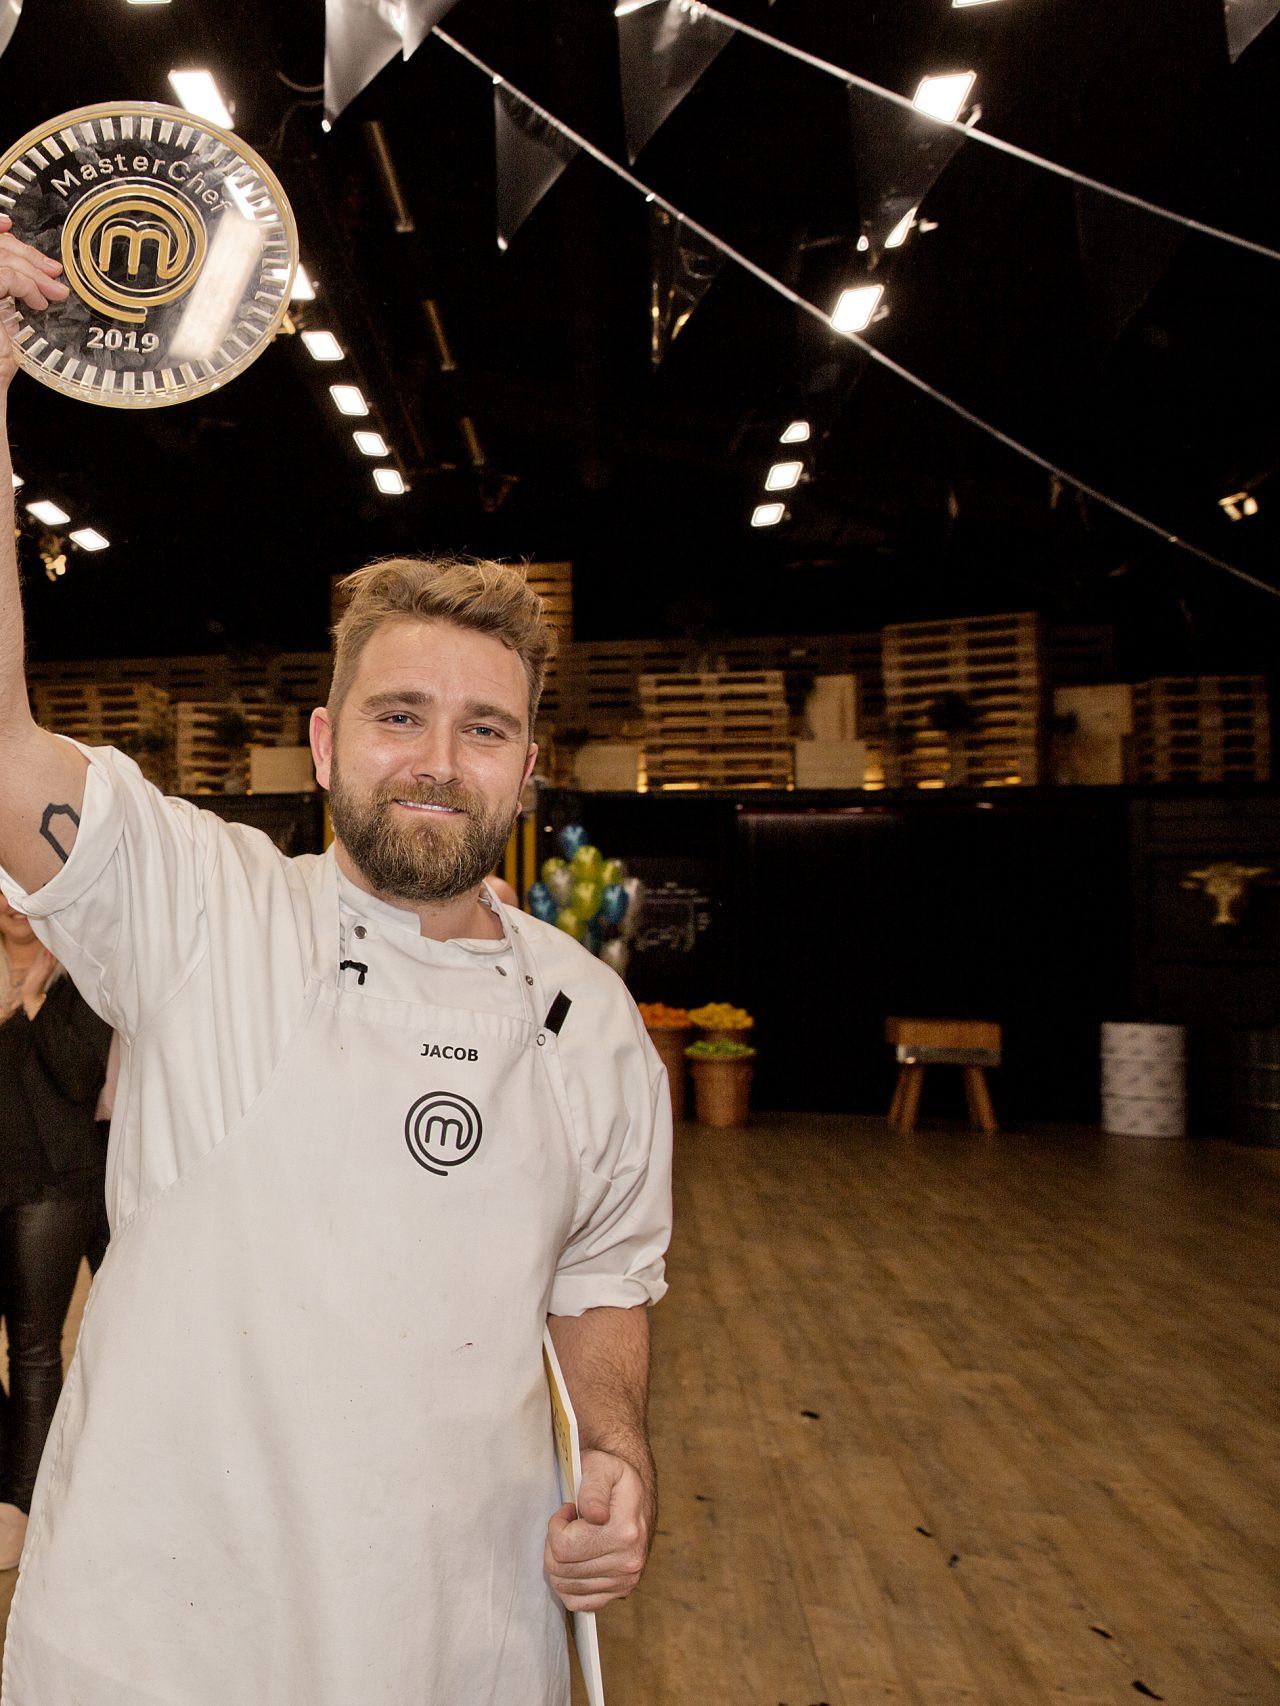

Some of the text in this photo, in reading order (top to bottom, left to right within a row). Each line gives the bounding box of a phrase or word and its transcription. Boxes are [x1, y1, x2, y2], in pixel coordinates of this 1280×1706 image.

[50, 153, 233, 212] MasterChef
[86, 326, 160, 354] 2019
[420, 1043, 479, 1062] JACOB
